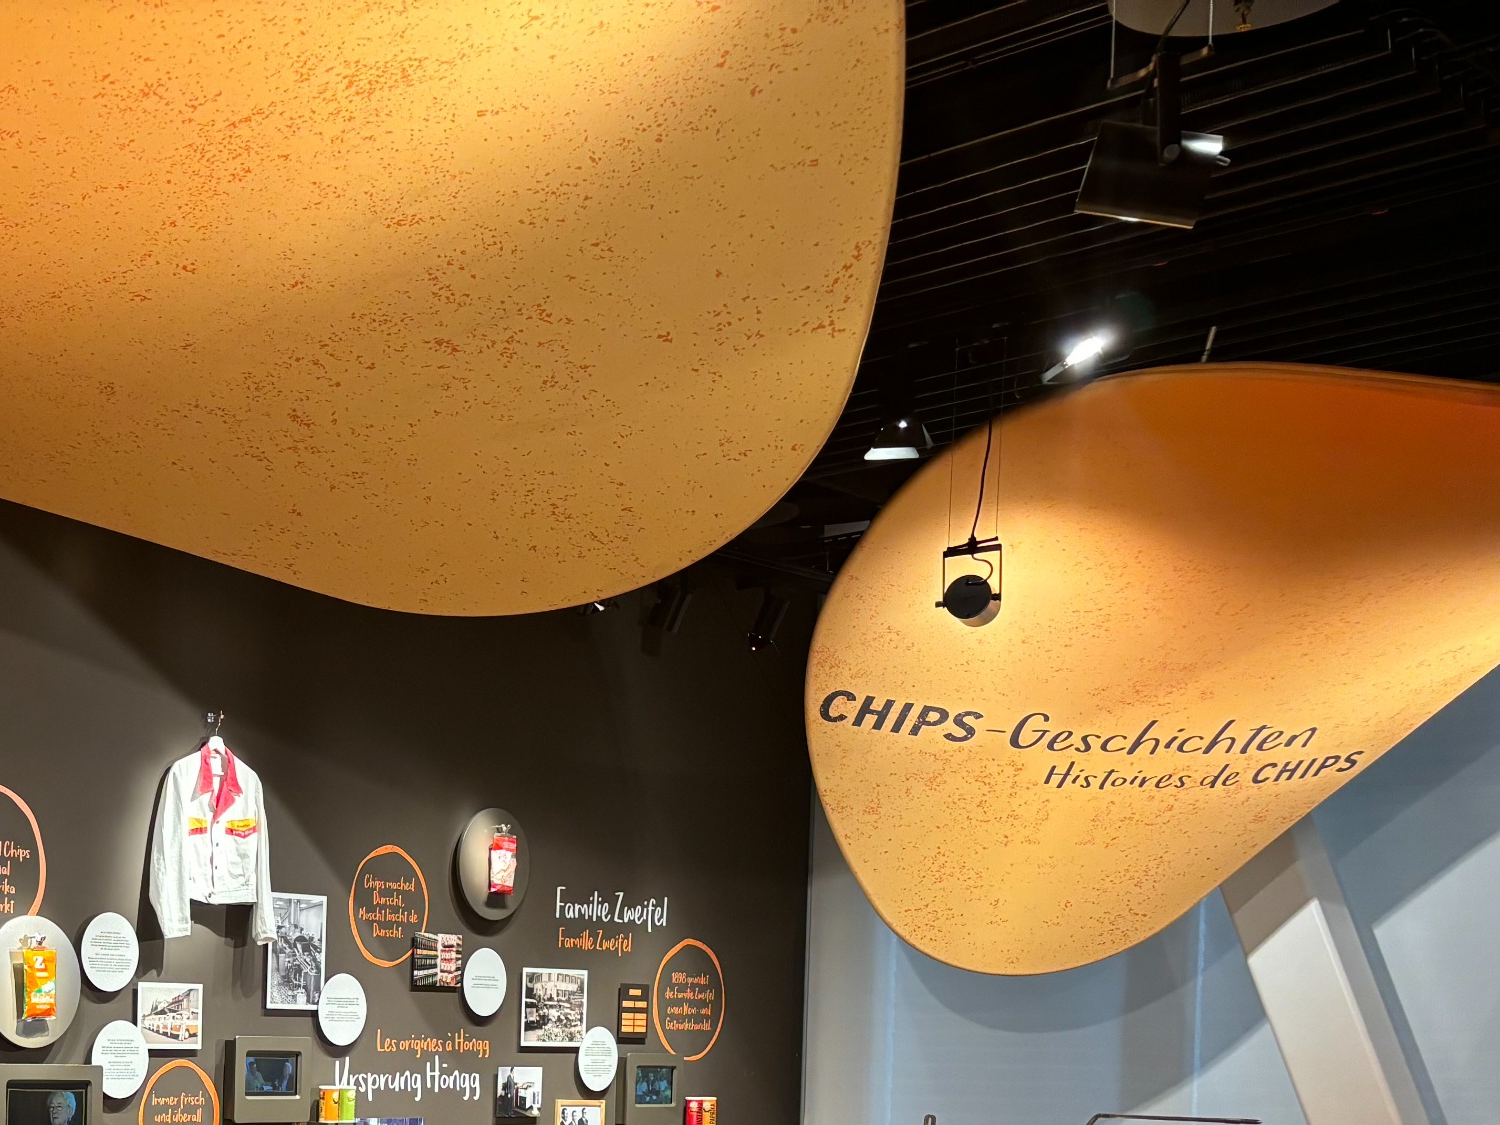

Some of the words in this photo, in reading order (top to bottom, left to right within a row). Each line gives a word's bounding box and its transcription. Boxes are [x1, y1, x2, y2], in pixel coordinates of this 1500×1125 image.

[1043, 761, 1186, 791] Histoires
[1201, 767, 1241, 789] de
[1252, 751, 1364, 785] CHIPS
[3, 841, 30, 862] Chips
[364, 873, 385, 891] Chips
[555, 886, 611, 922] Familie
[614, 892, 668, 932] Zweifel
[596, 929, 632, 957] Zweifel
[377, 1029, 398, 1053] Les
[399, 1033, 443, 1058] origines
[454, 1028, 490, 1058] Höngg
[334, 1056, 422, 1101] Ursprung
[426, 1055, 480, 1101] Höngg
[151, 1090, 179, 1107] Immer
[180, 1089, 205, 1107] frisch
[154, 1112, 172, 1124] und
[173, 1108, 203, 1124] überall
